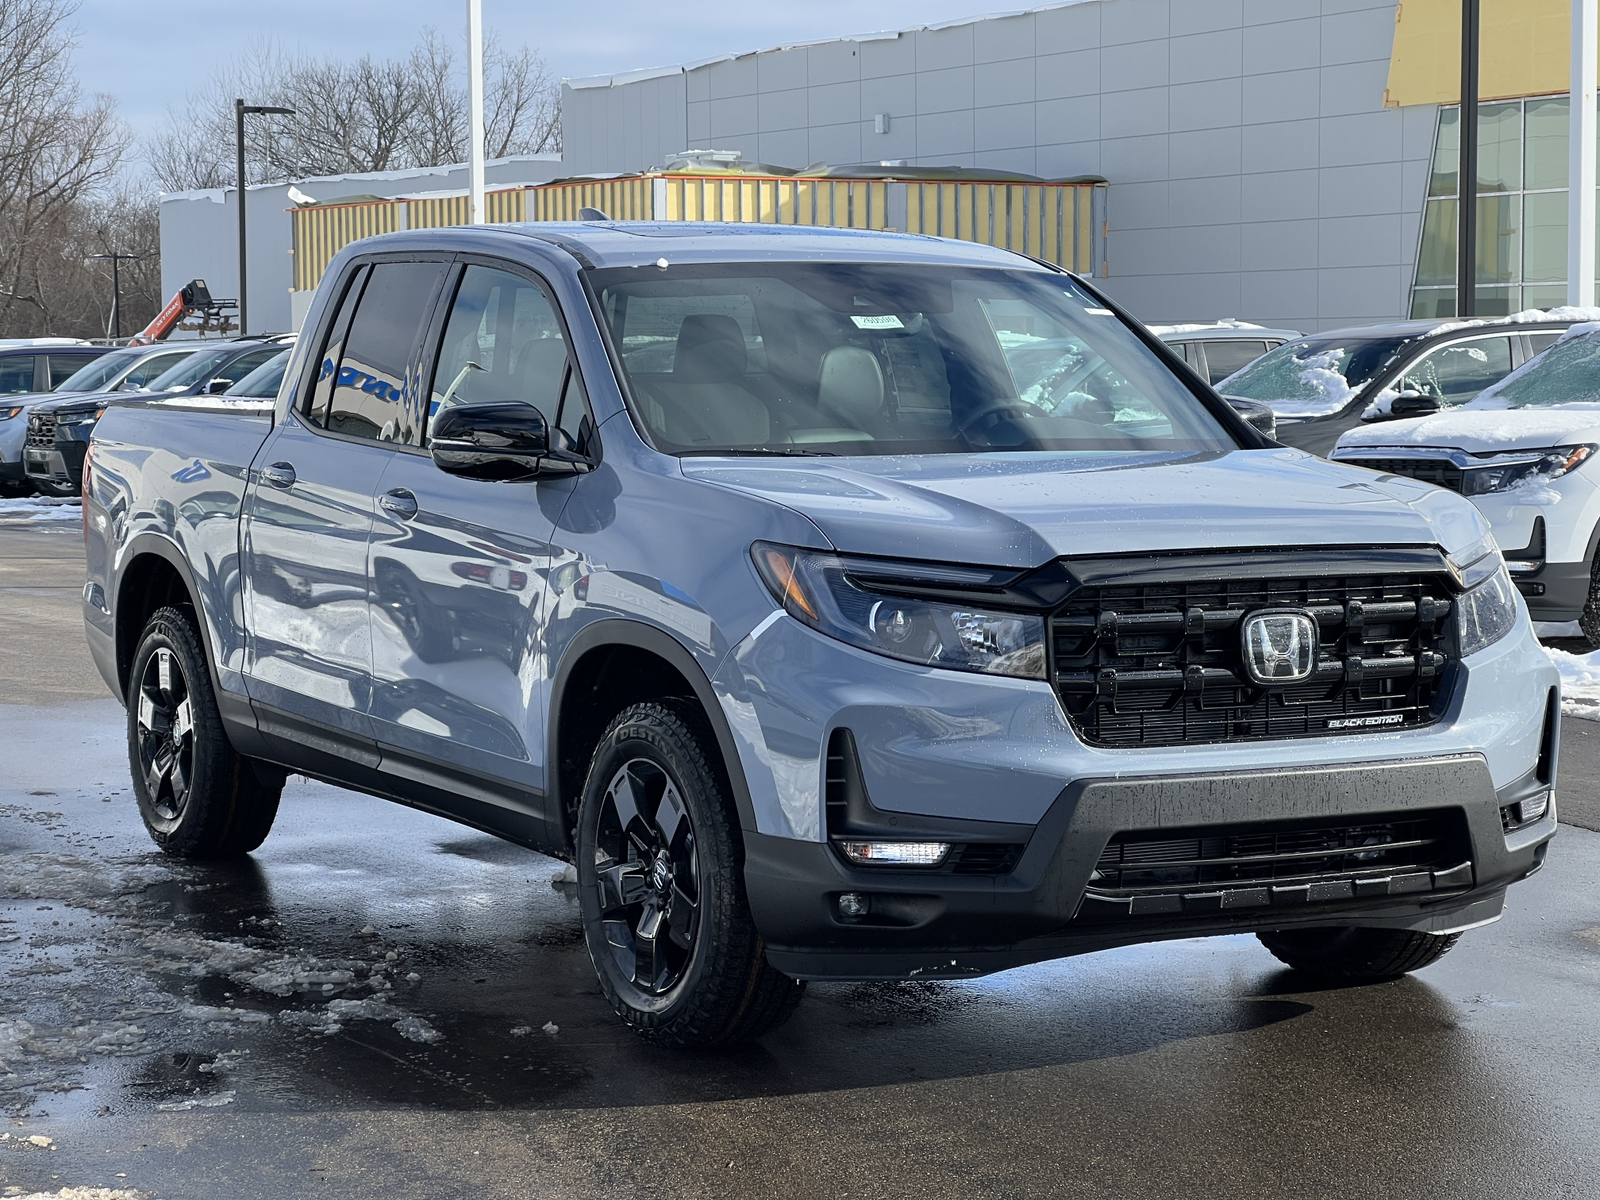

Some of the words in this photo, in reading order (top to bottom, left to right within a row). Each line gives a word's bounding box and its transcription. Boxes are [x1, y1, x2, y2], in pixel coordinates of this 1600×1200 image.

[156, 301, 178, 327] SKYTRAK
[1328, 718, 1366, 728] BLACK
[1366, 714, 1403, 725] EDITION
